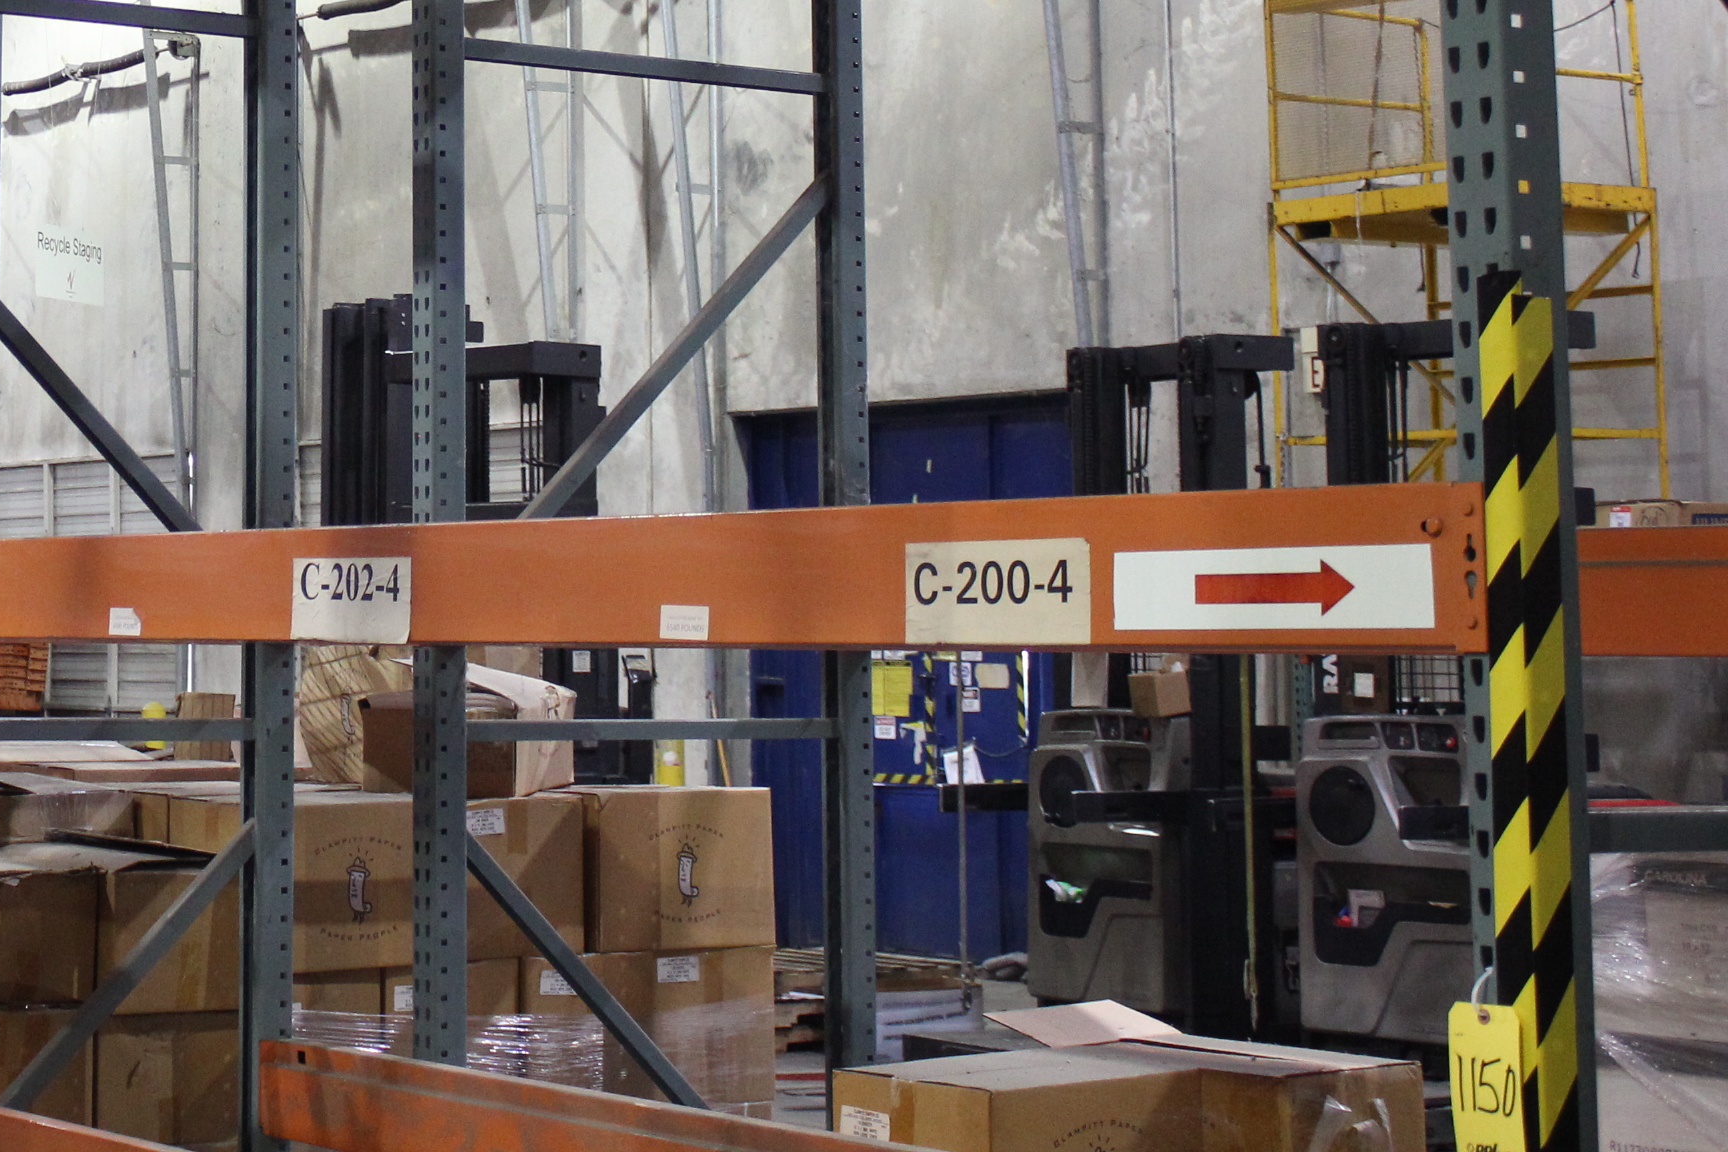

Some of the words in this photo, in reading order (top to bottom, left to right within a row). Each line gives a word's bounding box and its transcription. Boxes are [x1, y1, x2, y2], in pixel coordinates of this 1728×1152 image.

[37, 231, 70, 256] Recycle
[73, 238, 102, 264] Staging
[300, 562, 400, 602] C-202-4
[914, 559, 1073, 606] C-200-4
[1456, 1052, 1516, 1117] 1150
